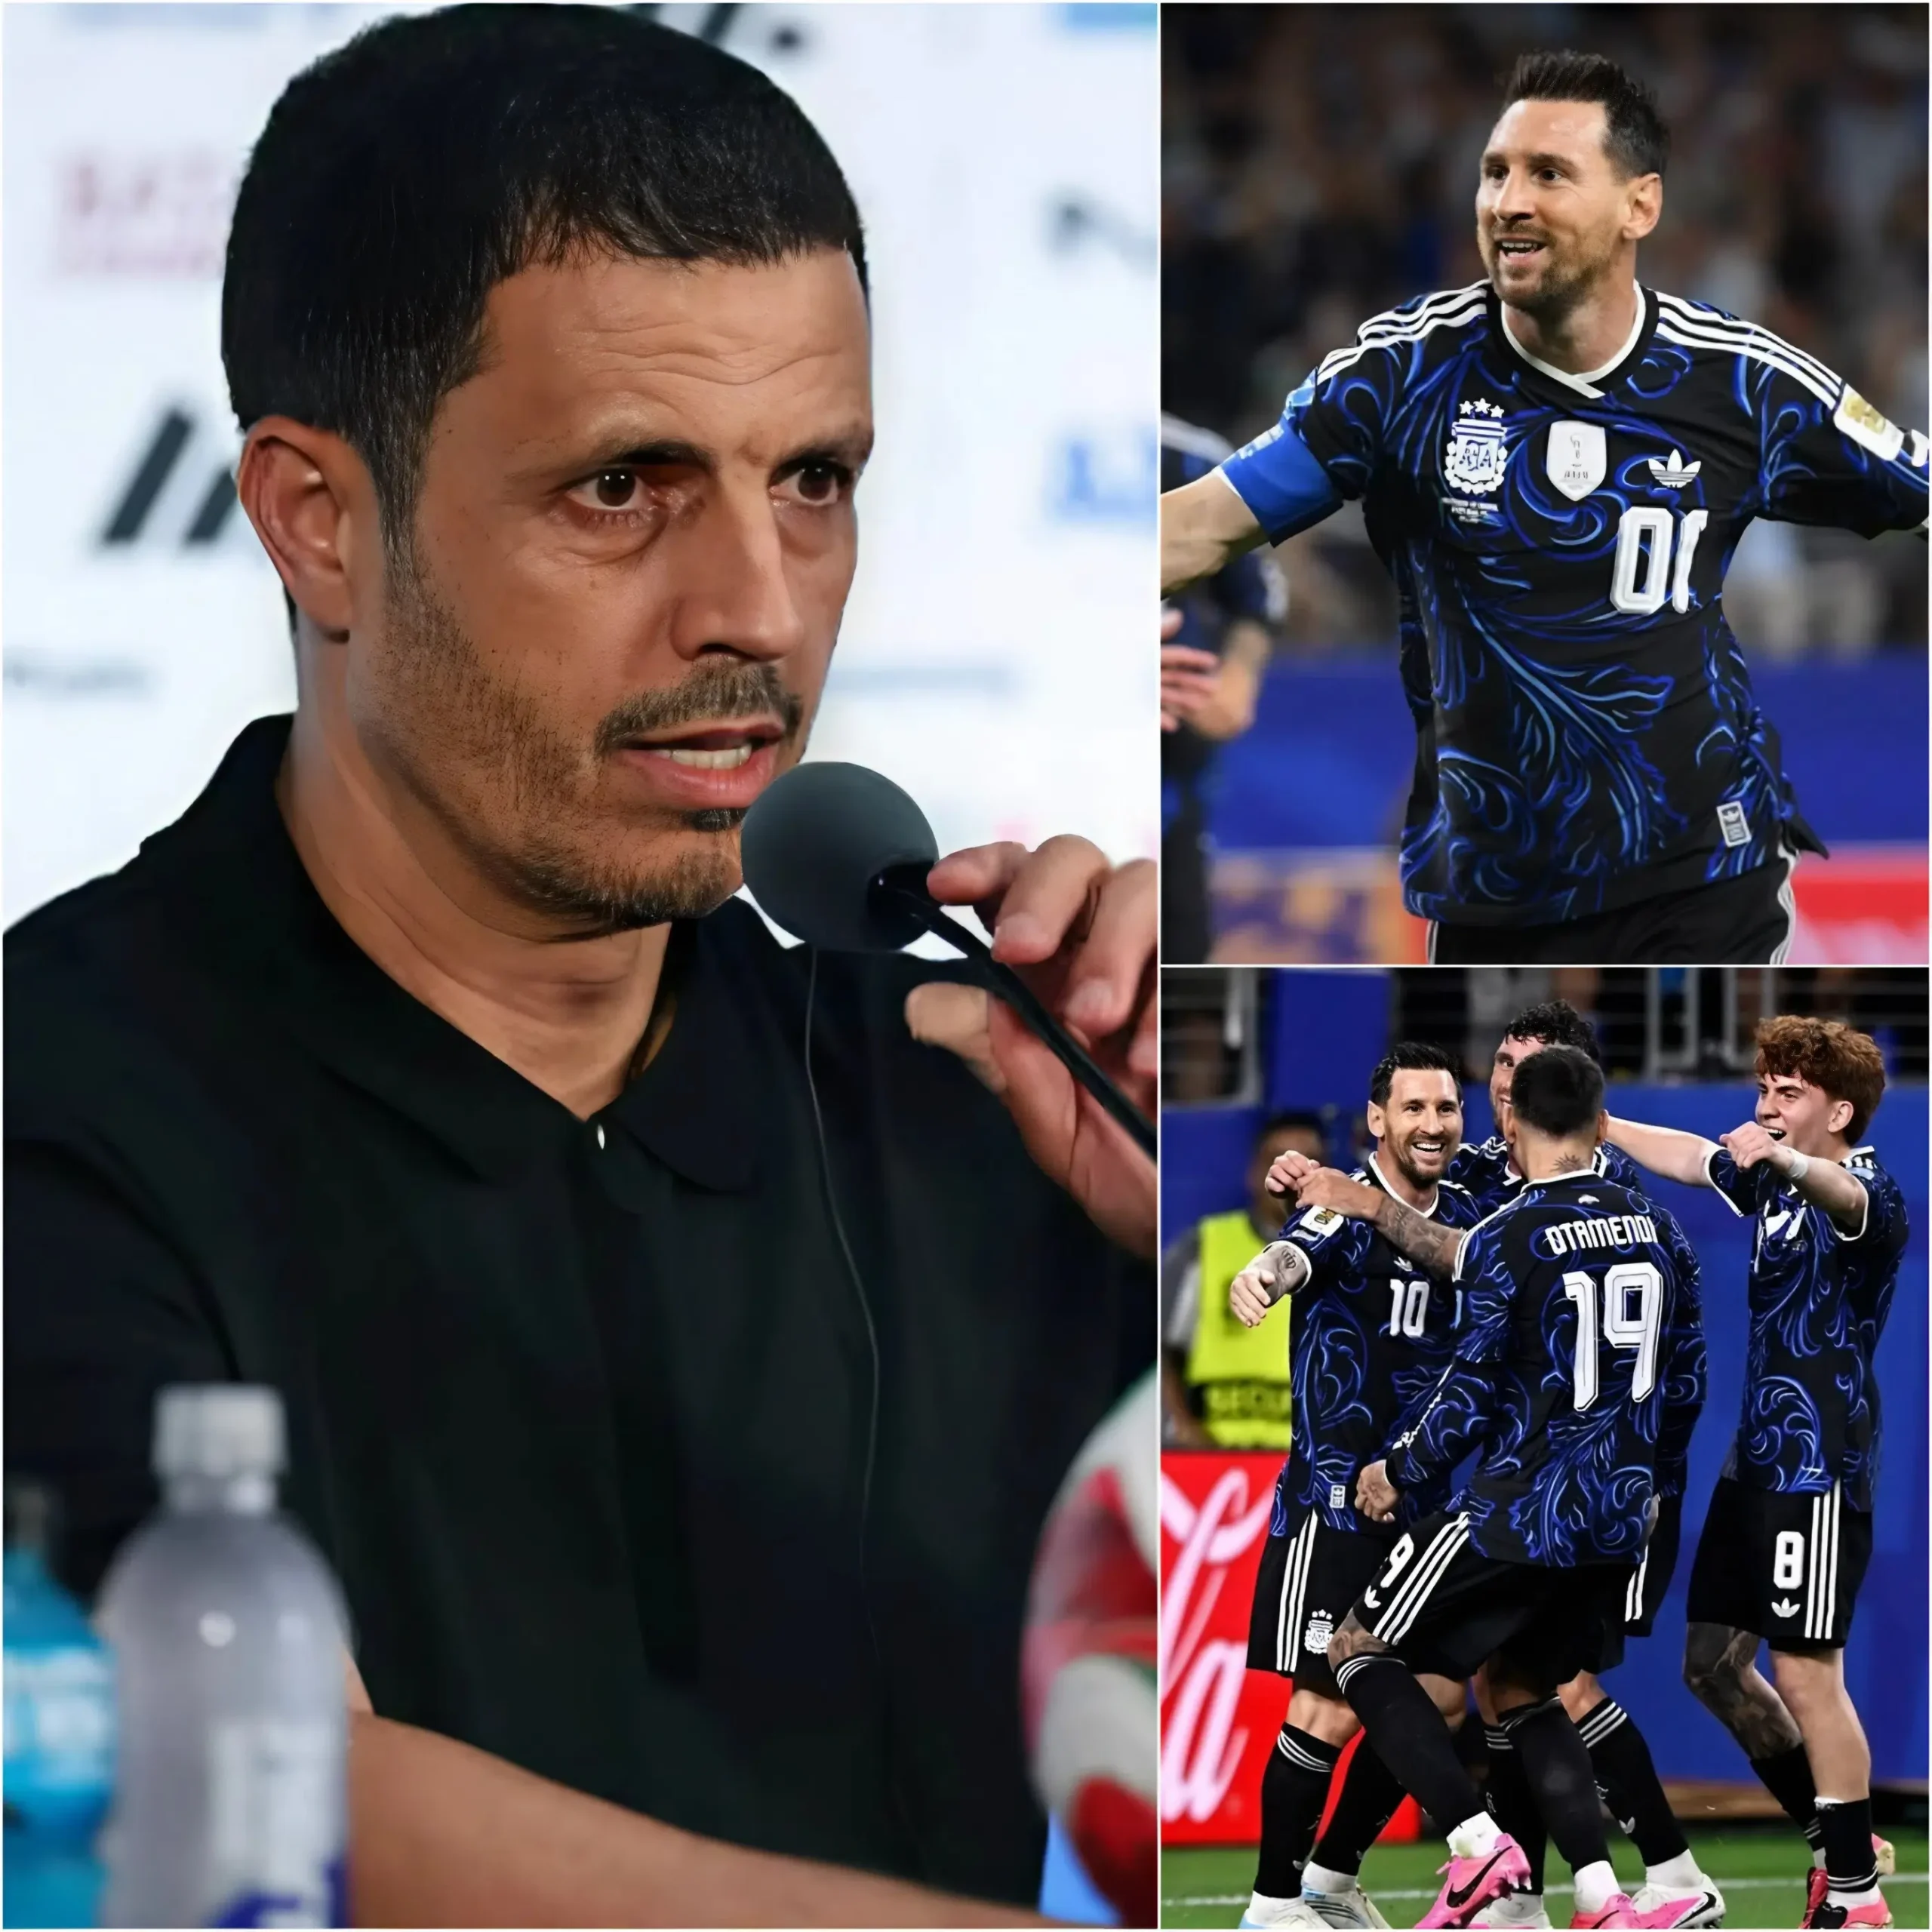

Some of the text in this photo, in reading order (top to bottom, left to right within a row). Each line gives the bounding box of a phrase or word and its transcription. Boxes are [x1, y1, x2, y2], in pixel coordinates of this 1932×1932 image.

[1545, 1215, 1658, 1255] OTAMENDI
[1389, 1278, 1430, 1338] 10
[1562, 1262, 1663, 1411] 19
[1380, 1532, 1414, 1588] 9
[1774, 1531, 1805, 1589] 8
